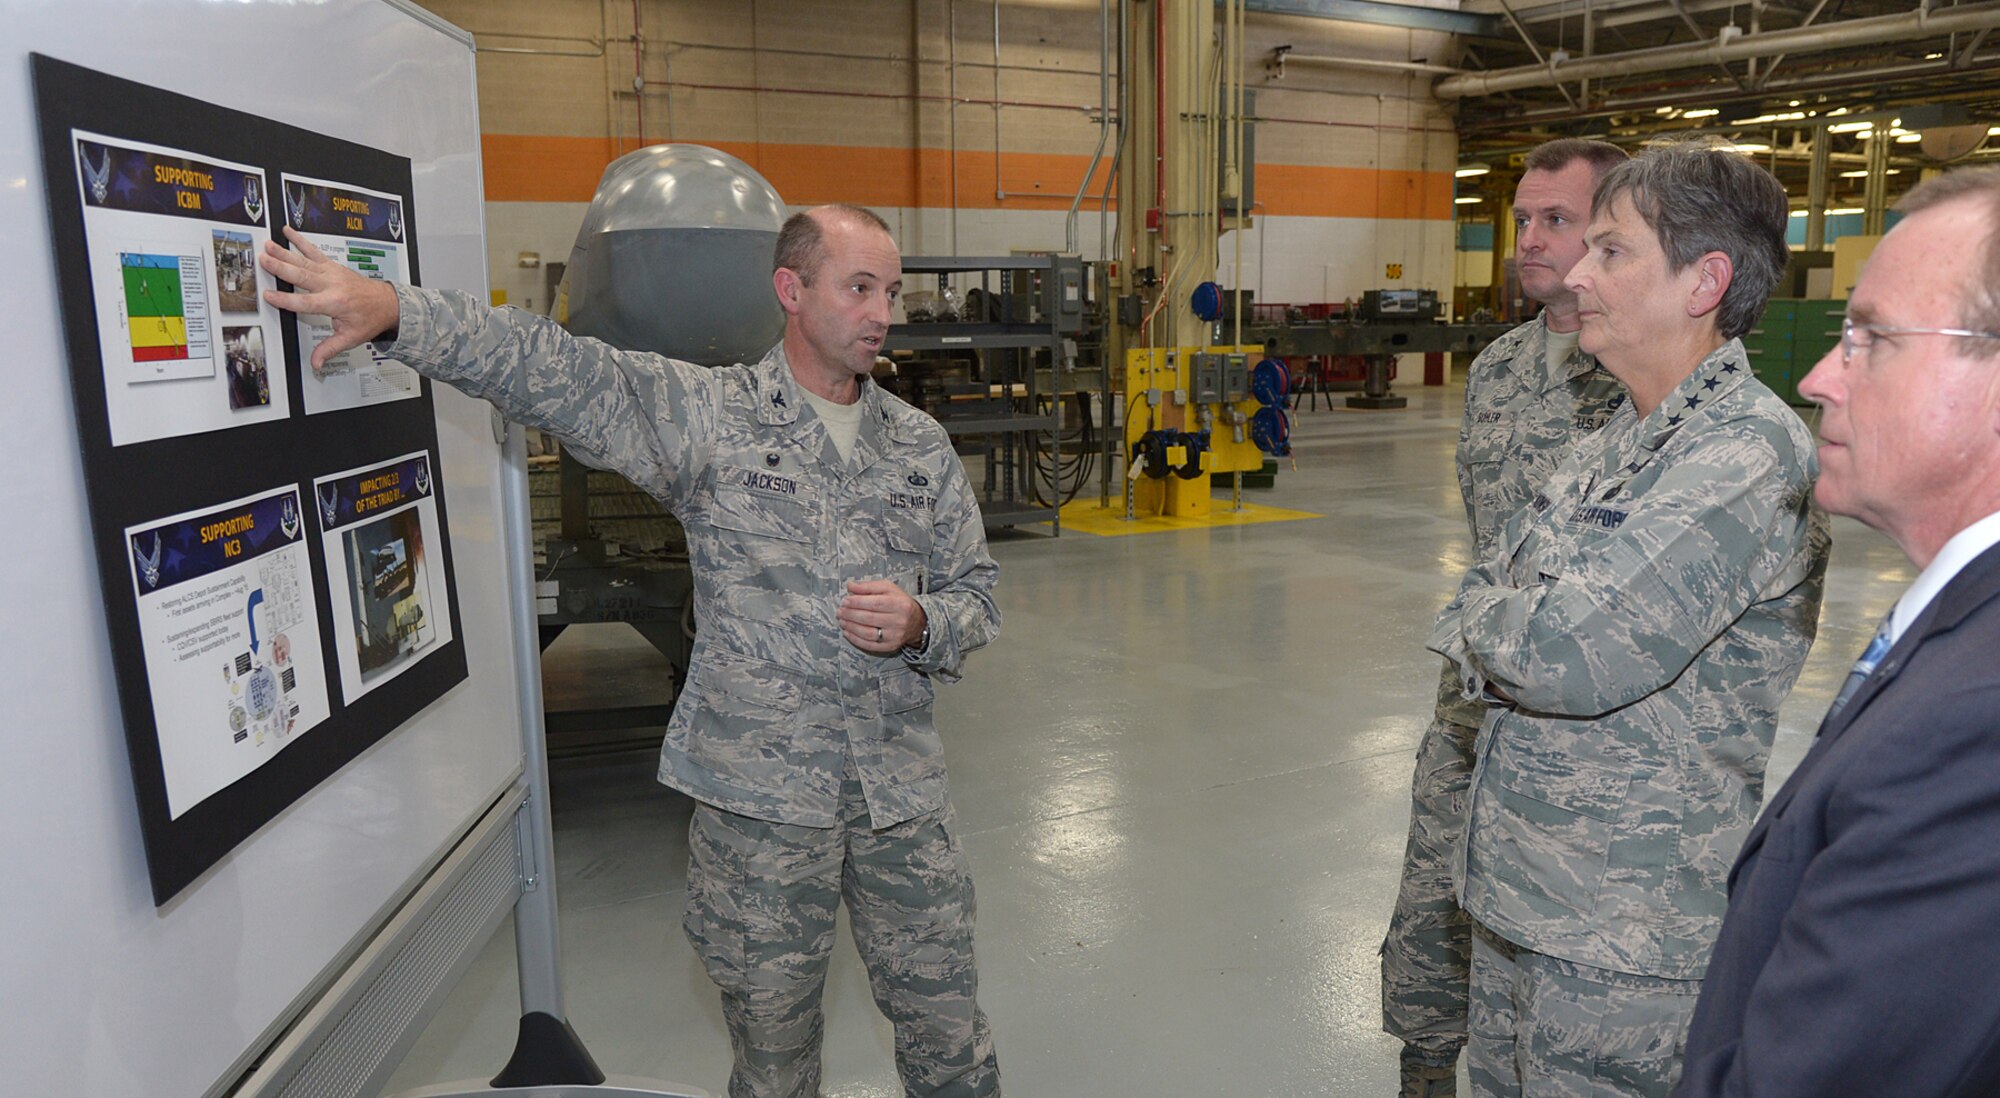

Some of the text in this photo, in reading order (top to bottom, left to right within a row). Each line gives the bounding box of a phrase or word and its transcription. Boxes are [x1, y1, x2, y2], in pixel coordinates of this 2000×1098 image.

[154, 164, 214, 191] SUPPORTING
[176, 190, 202, 209] ICBM
[332, 195, 370, 216] SUPPORTING
[346, 215, 364, 231] ALCM
[1576, 417, 1595, 430] U.S.
[359, 473, 391, 495] IMPACTING
[742, 470, 797, 495] JACKSON
[355, 498, 366, 513] OF
[364, 494, 379, 511] THE
[377, 489, 395, 507] TRIAD
[890, 492, 910, 509] U.S.
[910, 495, 926, 510] AIR
[200, 513, 255, 544] SUPPORTING
[223, 538, 242, 558] NC3
